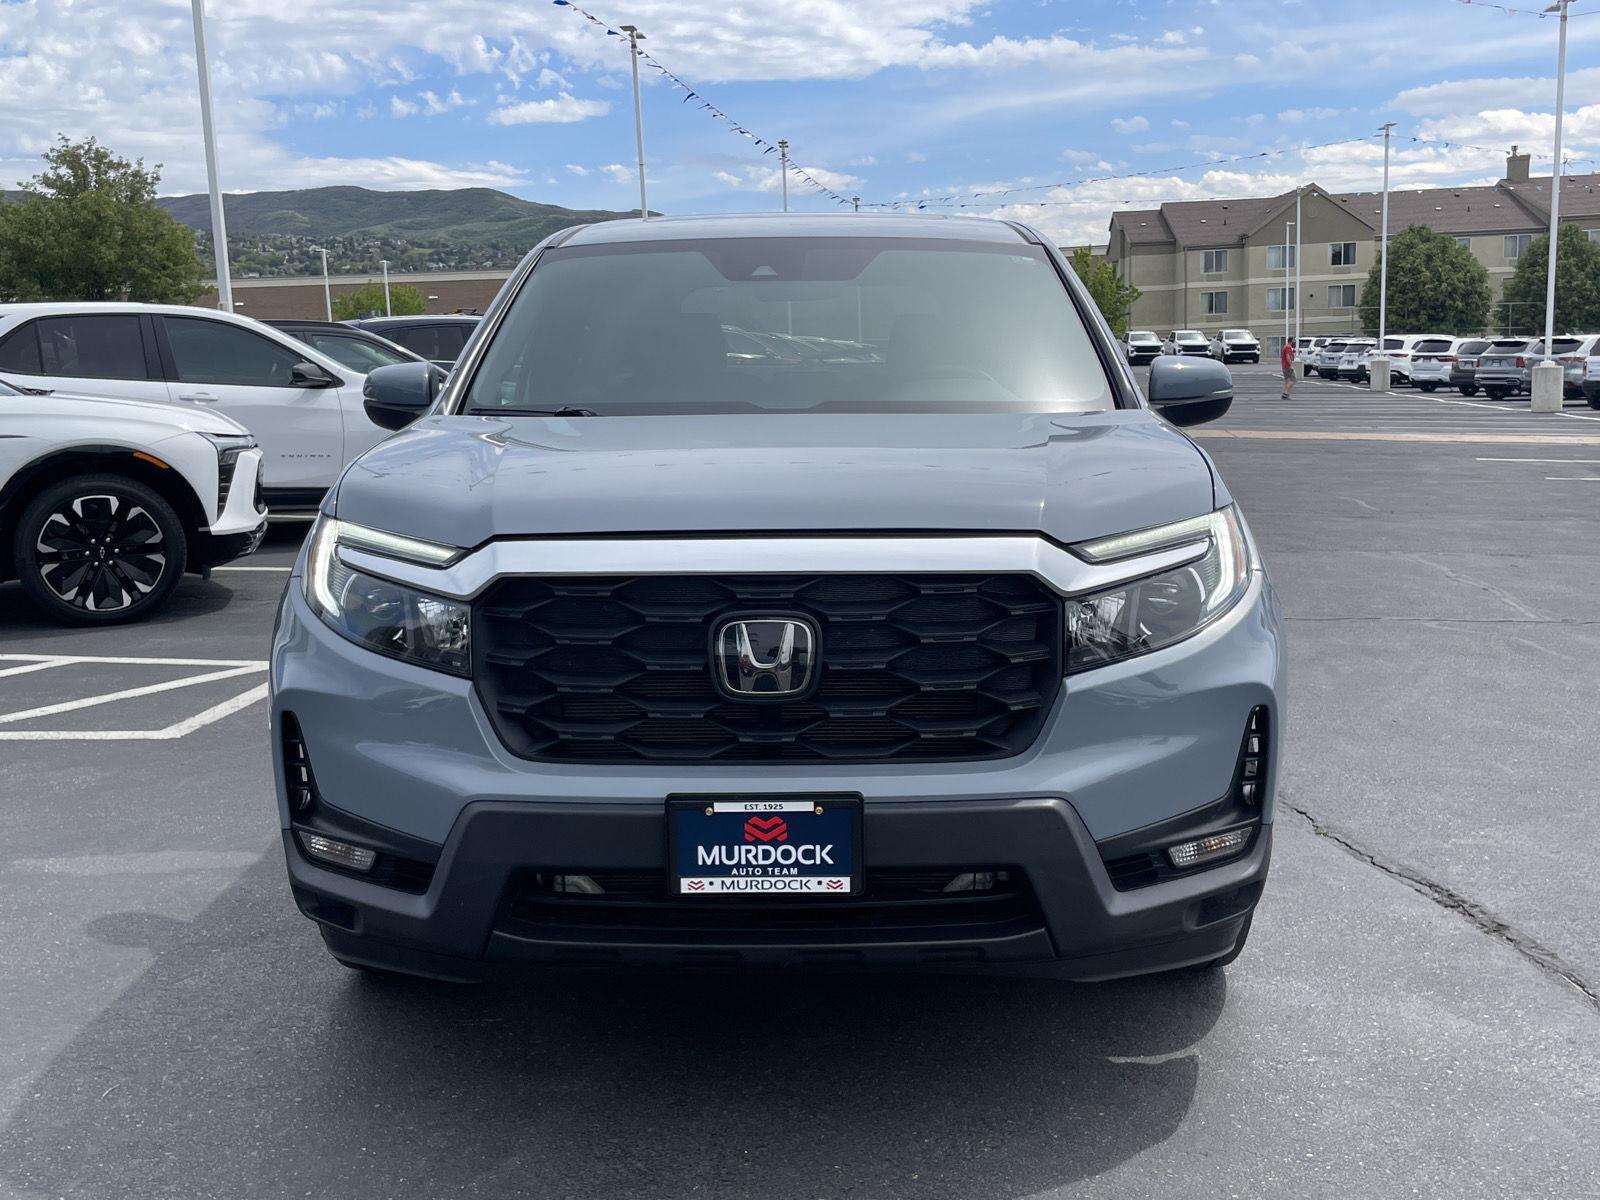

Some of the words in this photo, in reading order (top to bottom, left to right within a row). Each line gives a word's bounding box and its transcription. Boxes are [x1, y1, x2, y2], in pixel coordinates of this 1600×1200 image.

[744, 803, 761, 811] EST.
[763, 803, 784, 811] 1925
[697, 844, 834, 866] MURDOCK
[731, 867, 762, 876] AUTO
[766, 867, 798, 876] TEAM
[720, 879, 812, 891] MURDOCK
